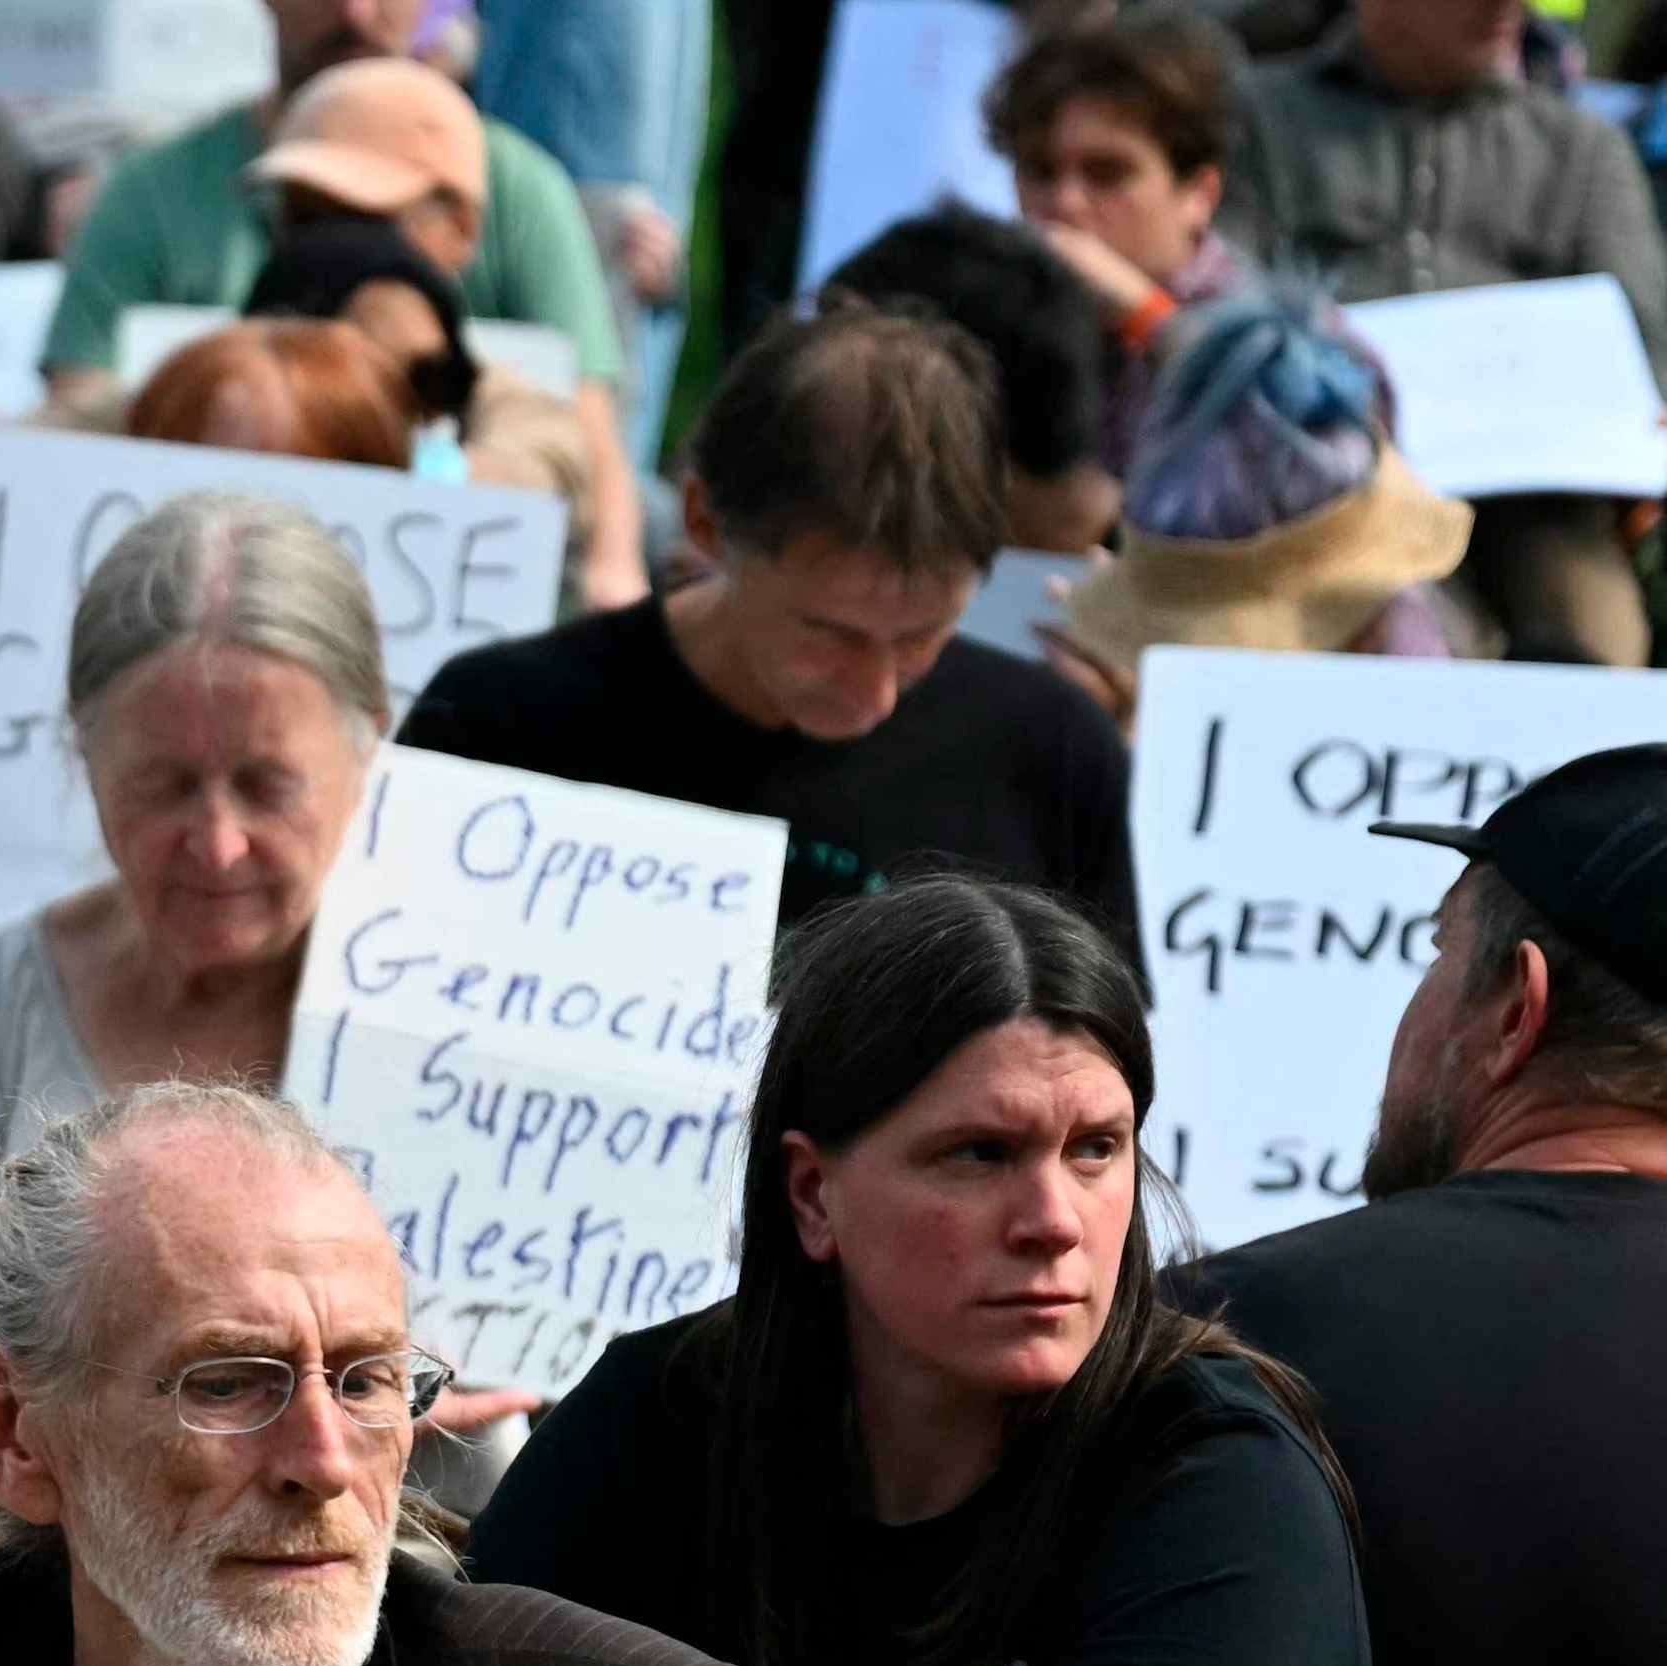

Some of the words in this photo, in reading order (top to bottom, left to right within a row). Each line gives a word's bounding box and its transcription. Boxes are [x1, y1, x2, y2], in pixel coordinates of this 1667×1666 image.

[367, 772, 392, 858] I
[456, 795, 750, 931] Oppose
[1193, 715, 1226, 838] I
[1290, 738, 1552, 822] OPP
[344, 908, 758, 1066] Genocide
[325, 1010, 350, 1103] I
[415, 1031, 742, 1192] Support
[337, 1146, 712, 1318] alestine
